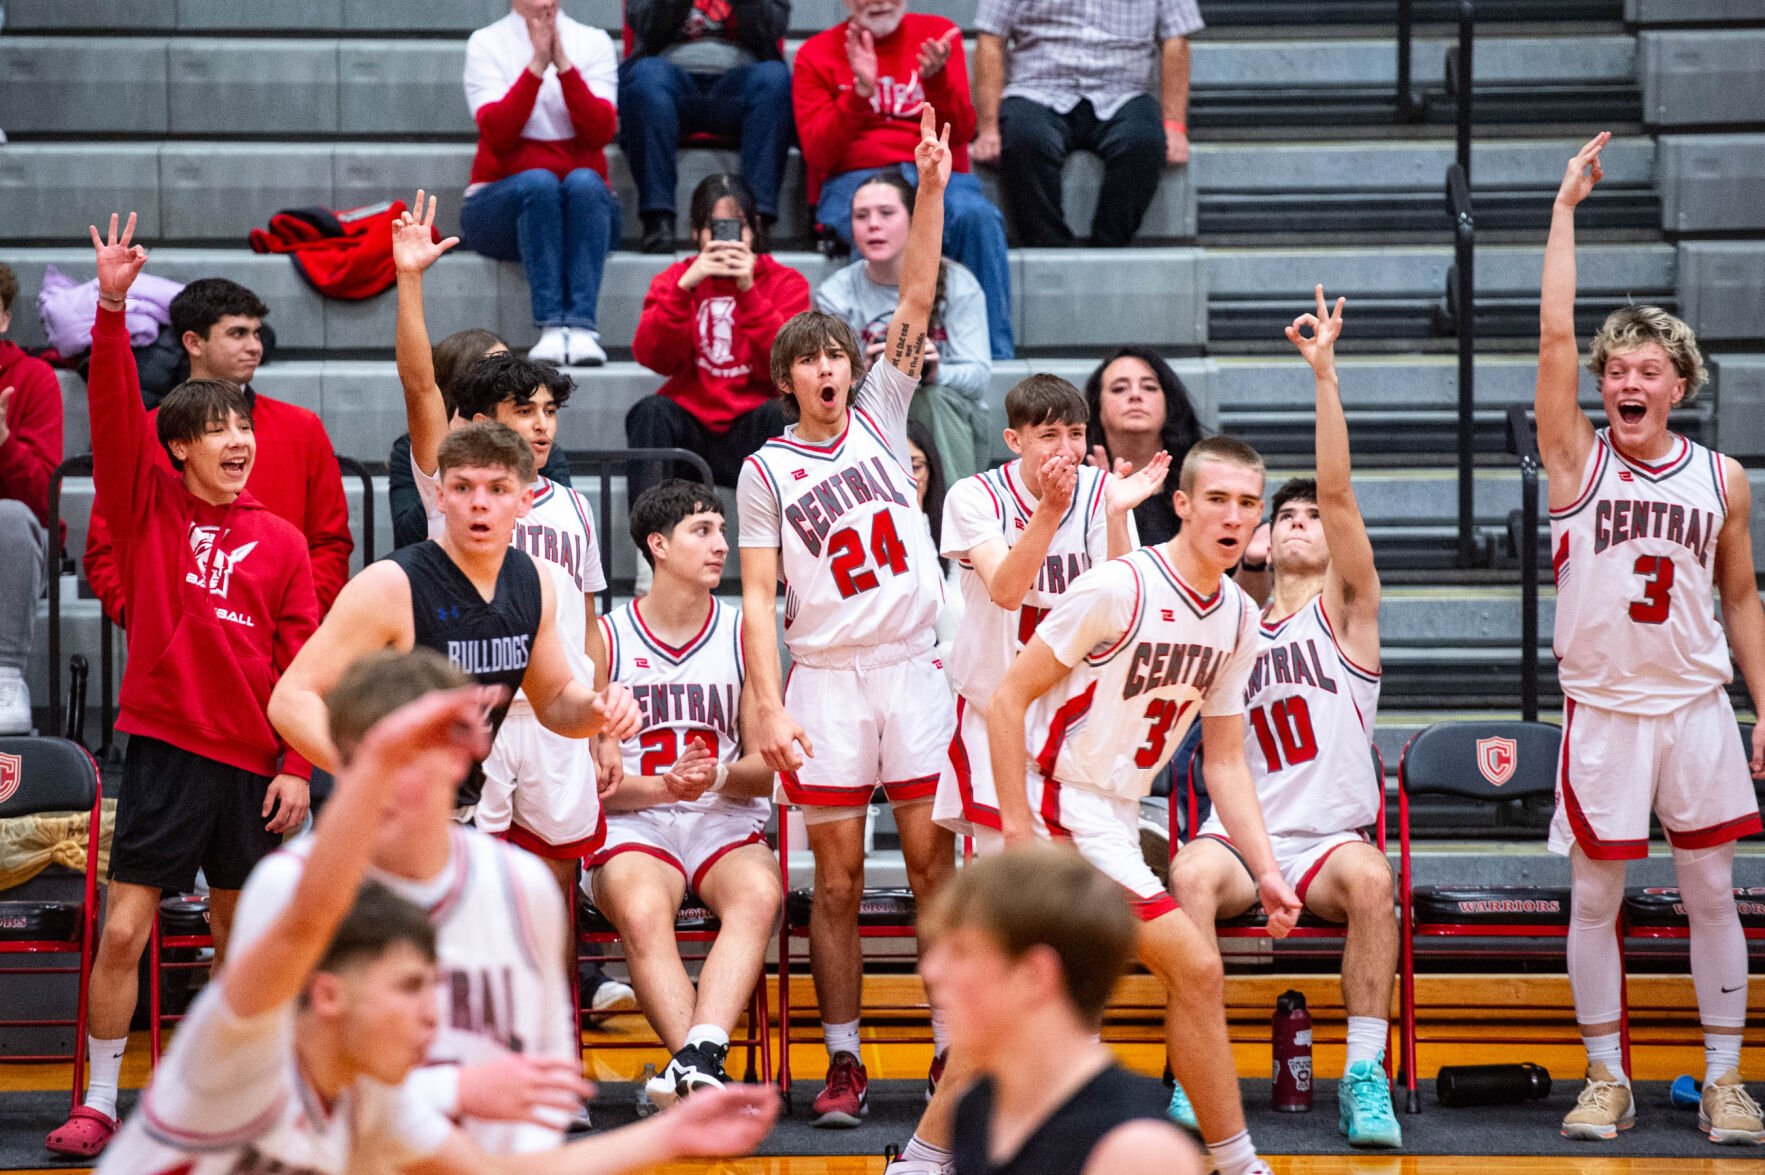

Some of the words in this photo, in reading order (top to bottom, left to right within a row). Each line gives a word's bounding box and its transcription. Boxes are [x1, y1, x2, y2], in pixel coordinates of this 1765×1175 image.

[784, 456, 910, 559] CENTRAL
[1594, 499, 1714, 570] CENTRAL
[511, 523, 584, 593] NTRAL
[826, 507, 910, 600] 24
[1628, 554, 1675, 625] 3
[447, 633, 530, 674] BULLDOGS
[1122, 642, 1231, 701] CENTRA
[620, 683, 737, 744] ENTRAL
[1134, 697, 1196, 770] 3
[1249, 694, 1319, 774] 10
[1458, 899, 1561, 913] WARRIORS
